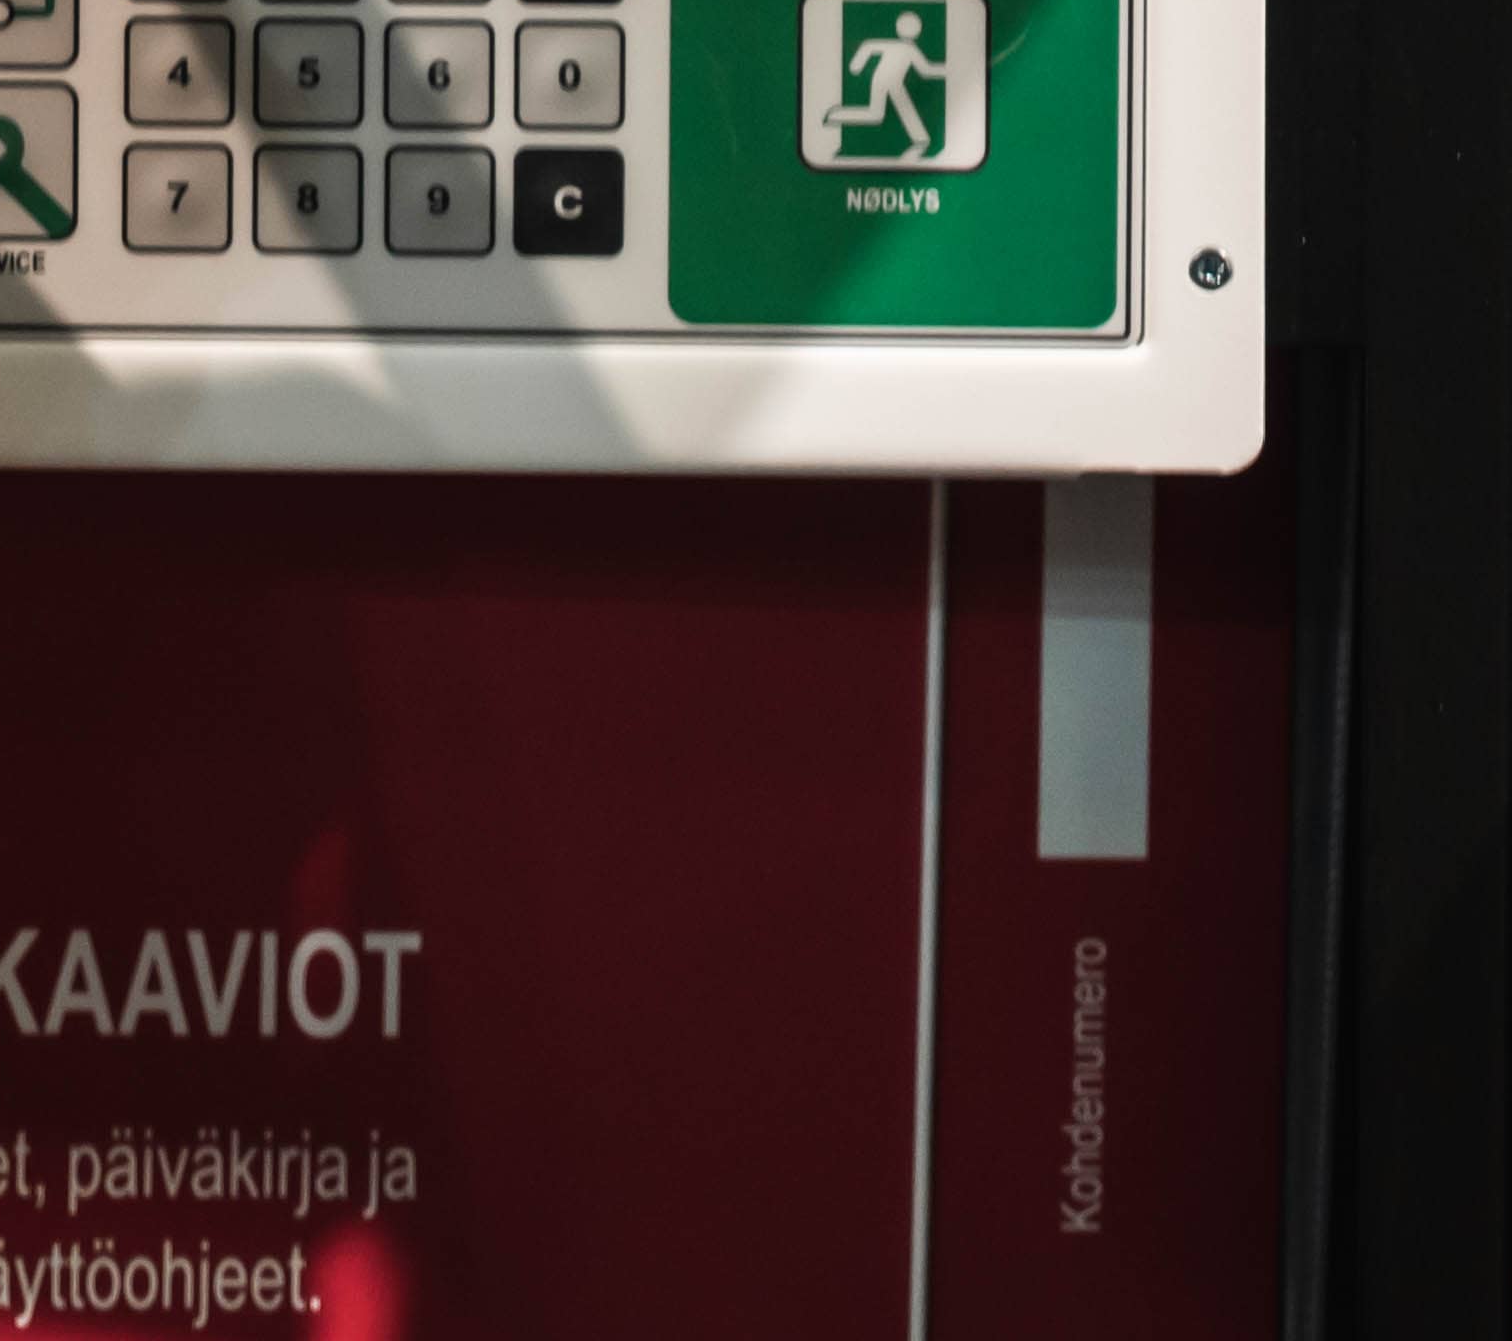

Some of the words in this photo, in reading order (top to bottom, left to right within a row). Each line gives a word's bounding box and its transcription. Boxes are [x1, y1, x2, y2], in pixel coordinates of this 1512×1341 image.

[167, 56, 193, 90] 4
[297, 57, 321, 91] 5
[427, 58, 452, 91] 6
[558, 59, 582, 94] 0
[168, 181, 189, 216] 7
[296, 182, 320, 217] 8
[426, 184, 451, 218] 9
[553, 184, 583, 219] C
[846, 187, 941, 215] NØDLYS
[1059, 937, 1108, 1233] Kohdenumero
[67, 1127, 348, 1219] päiväkirja
[361, 1129, 417, 1222] ja
